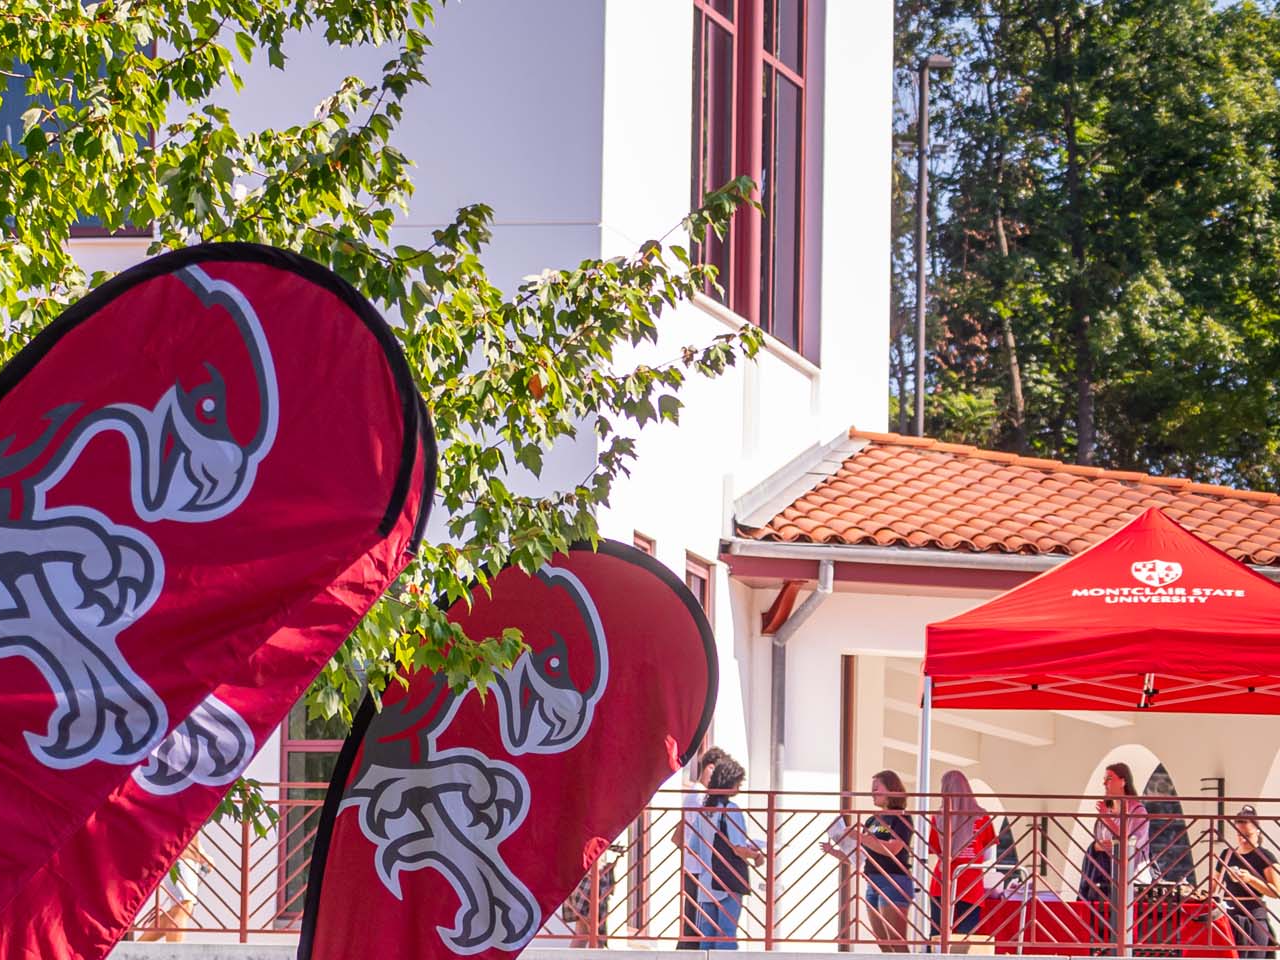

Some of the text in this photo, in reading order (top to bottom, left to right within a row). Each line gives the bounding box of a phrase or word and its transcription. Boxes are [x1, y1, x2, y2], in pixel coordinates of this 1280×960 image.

[1072, 587, 1245, 597] MONTCLAIR STATE
[1105, 596, 1208, 604] UNIVERSITY
